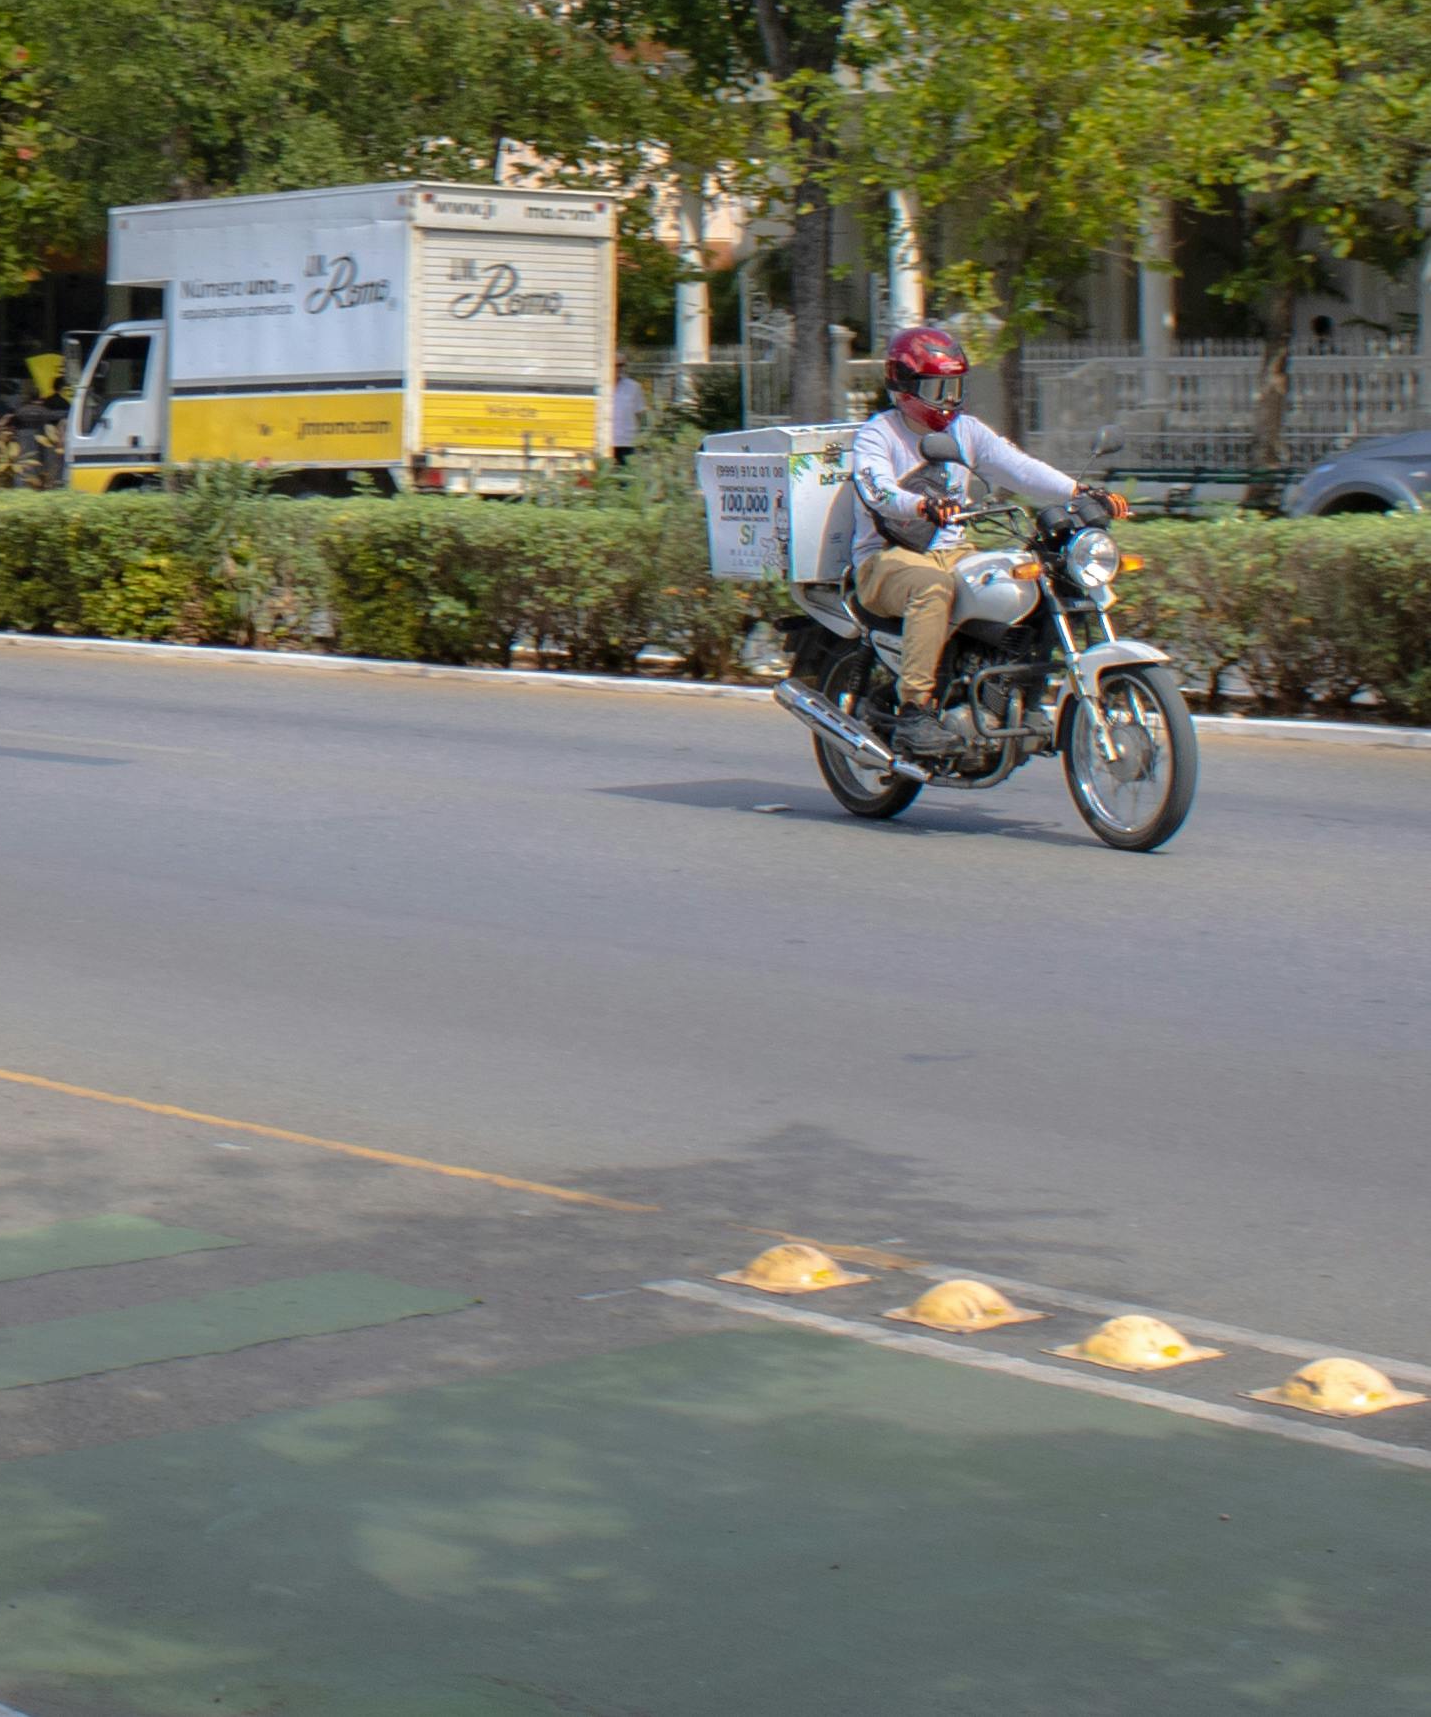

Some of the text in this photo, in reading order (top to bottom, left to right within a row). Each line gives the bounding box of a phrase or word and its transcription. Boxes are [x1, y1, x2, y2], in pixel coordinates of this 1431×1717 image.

[304, 256, 390, 315] Romo
[449, 263, 564, 320] Romo
[720, 493, 769, 514] 100,000
